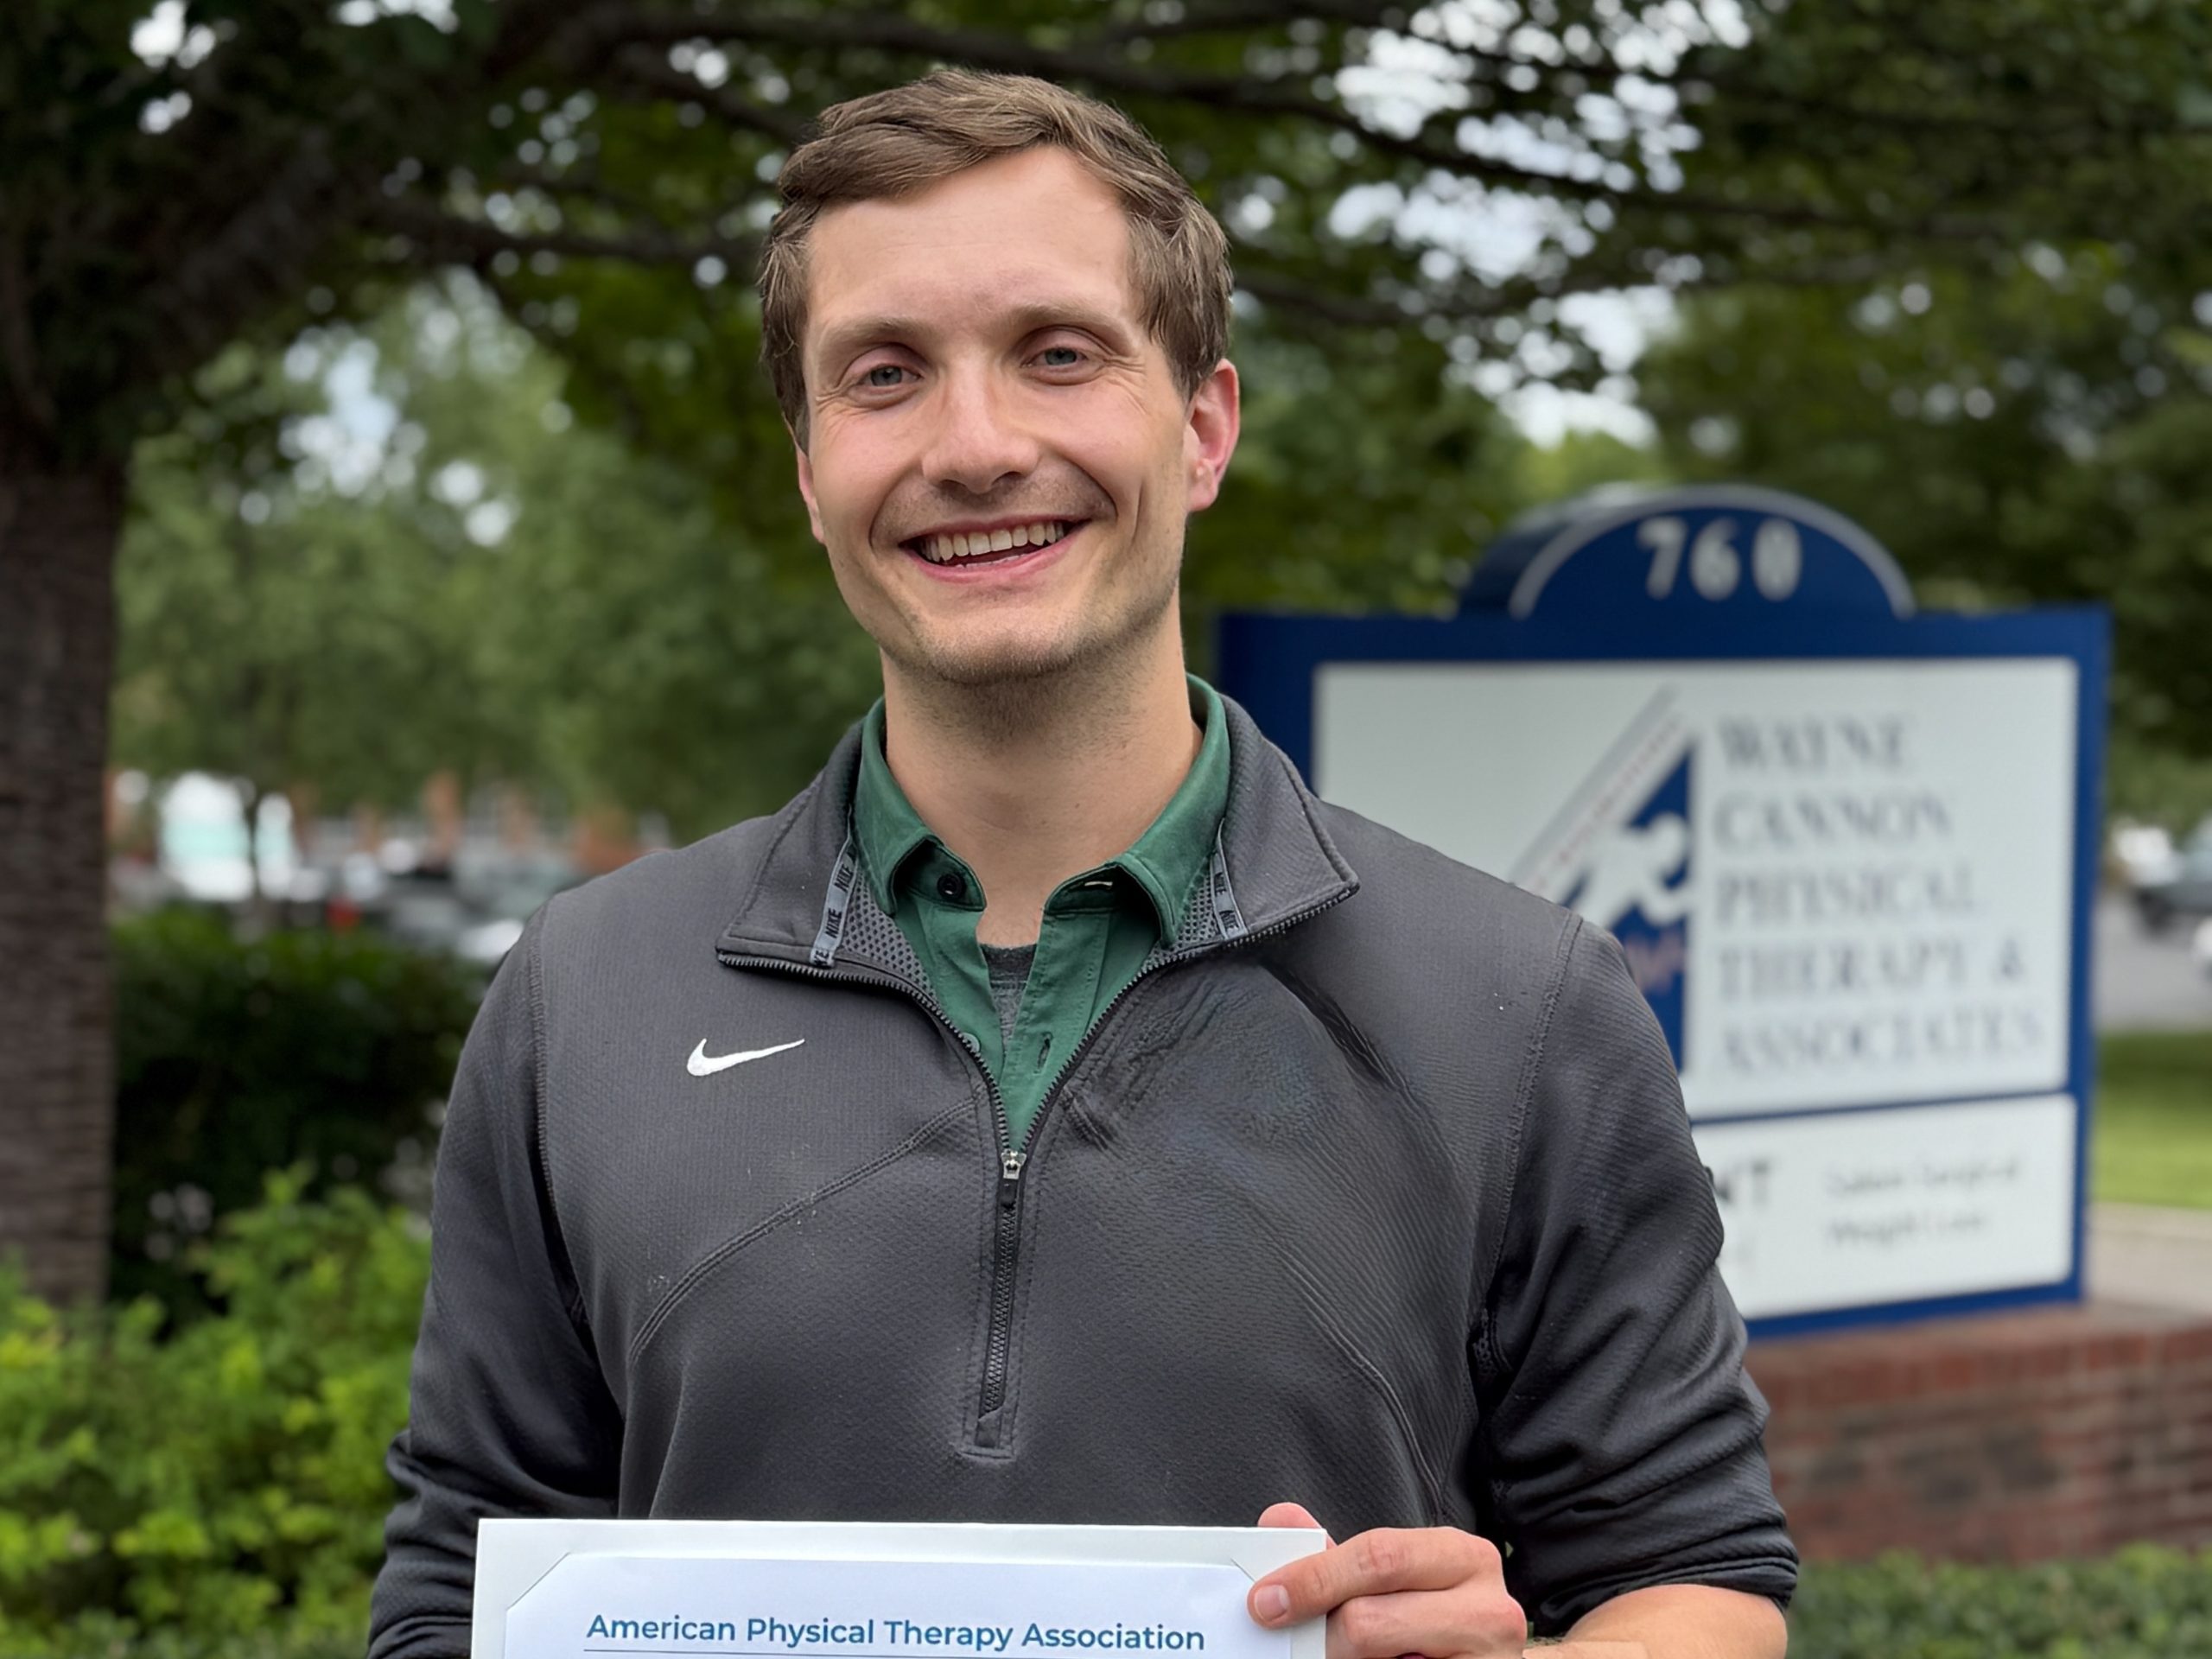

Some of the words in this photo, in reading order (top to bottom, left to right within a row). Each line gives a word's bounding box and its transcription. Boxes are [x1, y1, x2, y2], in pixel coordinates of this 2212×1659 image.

[1637, 516, 1802, 601] 760
[1718, 714, 1919, 772] WAYNE
[1713, 790, 1955, 854] CANNON
[825, 908, 842, 938] NIKE
[1715, 861, 1986, 927] PHYSICAL
[1718, 936, 1972, 1002] THERAPY
[1719, 1007, 2044, 1072] ASSOCIATES
[587, 1614, 735, 1641] American
[747, 1618, 874, 1648] Physical
[883, 1620, 1014, 1651] Therapy
[1021, 1622, 1205, 1650] Association
